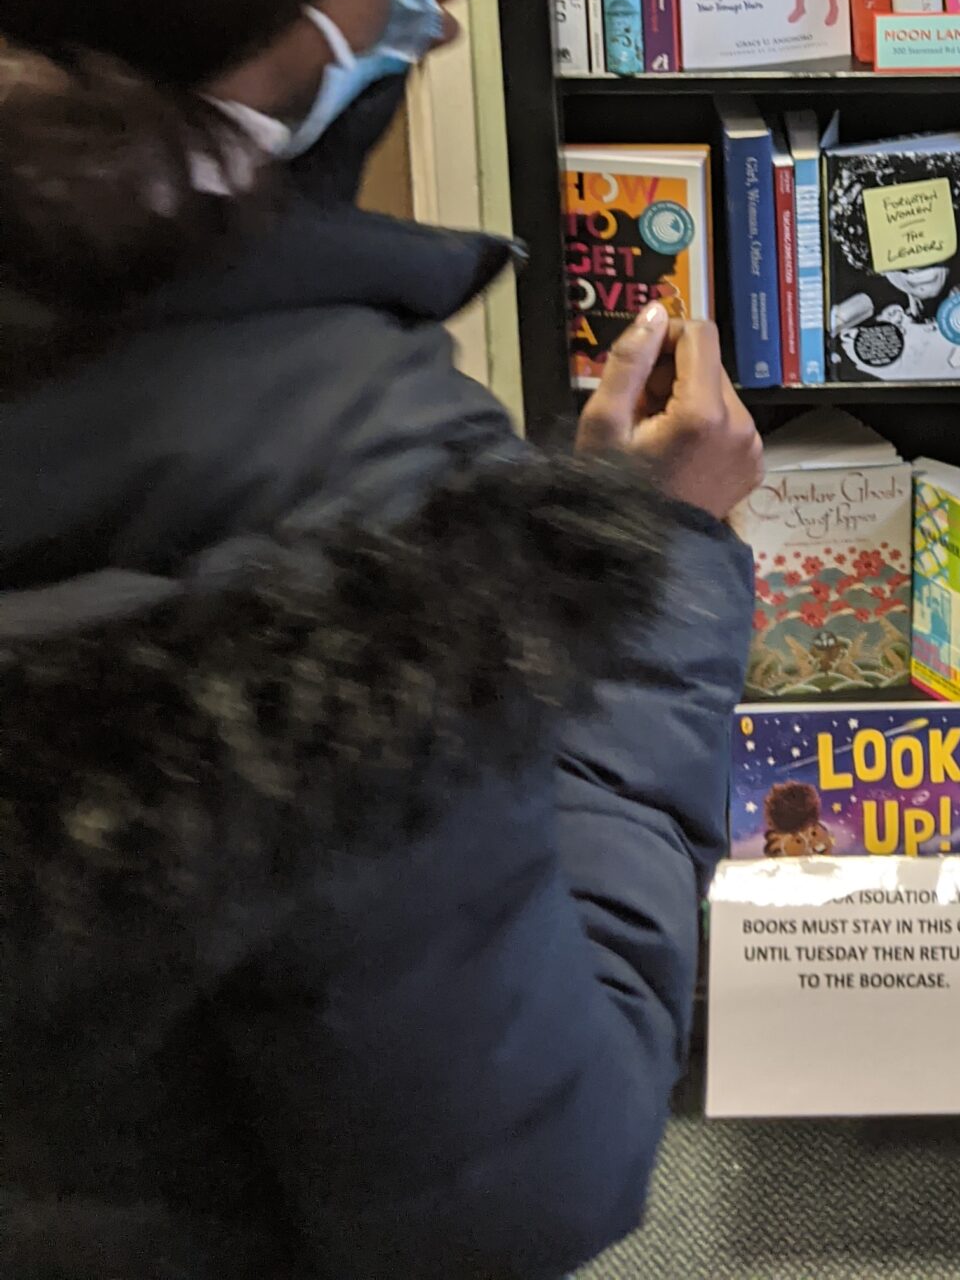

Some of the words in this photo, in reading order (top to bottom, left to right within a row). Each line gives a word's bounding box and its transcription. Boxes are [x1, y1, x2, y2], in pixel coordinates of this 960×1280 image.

[884, 29, 931, 42] MOON
[745, 156, 759, 187] Girl,
[566, 171, 660, 206] HOW
[566, 209, 618, 240] TO
[747, 188, 761, 239] Woman,
[887, 204, 933, 223] WOMEN
[887, 242, 944, 262] LEADERS
[902, 231, 925, 243] THE
[566, 242, 642, 278] GET
[751, 239, 762, 276] Other
[841, 472, 904, 503] Ghosh
[862, 796, 953, 857] UP!
[743, 919, 798, 935] BOOKS
[802, 919, 848, 935] MUST
[852, 919, 892, 935] STAY
[896, 919, 913, 934] IN
[919, 919, 953, 934] THIS
[744, 946, 791, 962] UNTIL
[795, 946, 869, 962] TUESDAY
[874, 946, 915, 961] THEN
[798, 974, 820, 989] TO
[825, 973, 856, 989] THE
[859, 973, 950, 989] BOOKCASE.
